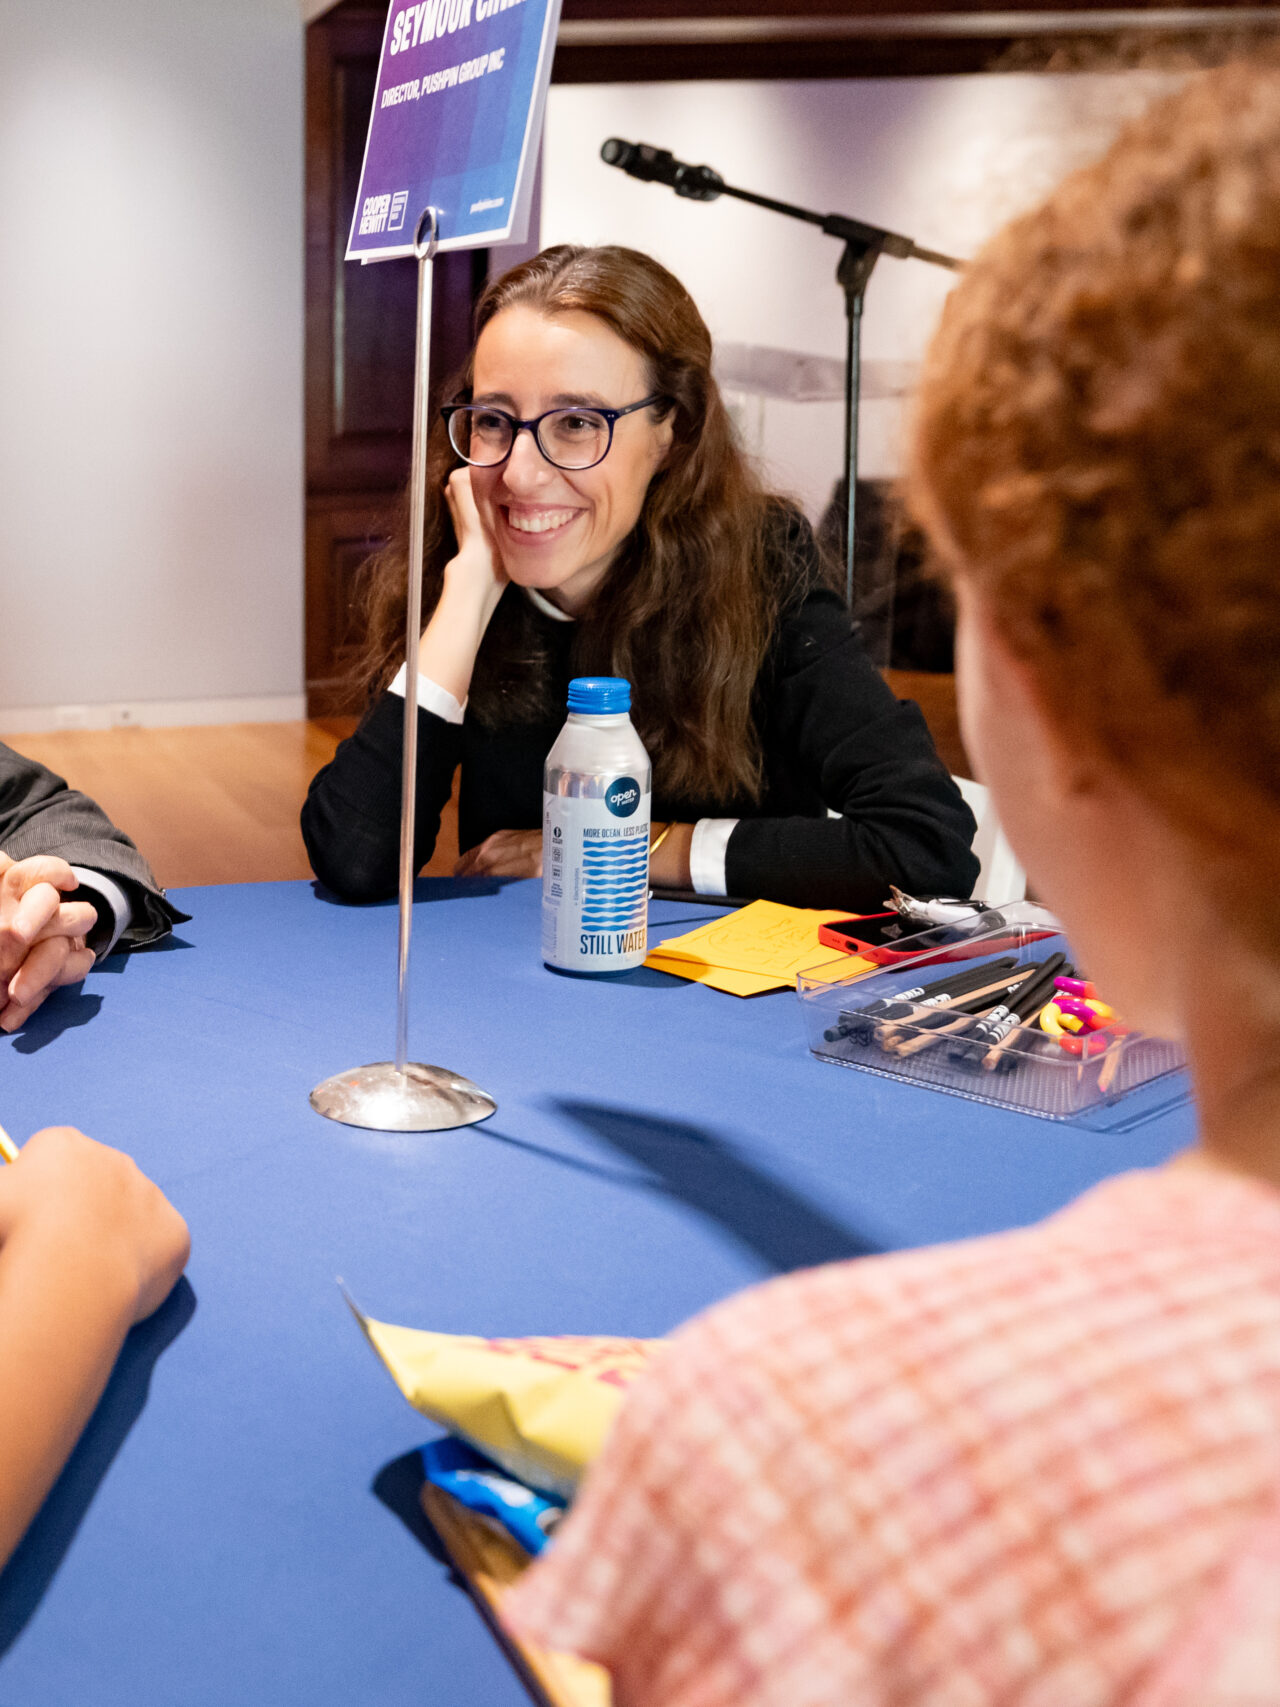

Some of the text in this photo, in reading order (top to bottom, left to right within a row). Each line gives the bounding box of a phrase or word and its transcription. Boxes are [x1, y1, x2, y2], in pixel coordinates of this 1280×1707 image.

[390, 0, 474, 56] SEYMOUR
[381, 79, 420, 109] DIRECTOR,
[421, 65, 460, 96] PUSHPIN
[458, 54, 489, 84] GROUP
[363, 194, 391, 217] COOPER
[610, 789, 637, 807] open
[583, 828, 600, 838] MORE
[623, 826, 635, 837] LESS
[580, 934, 613, 955] STILL
